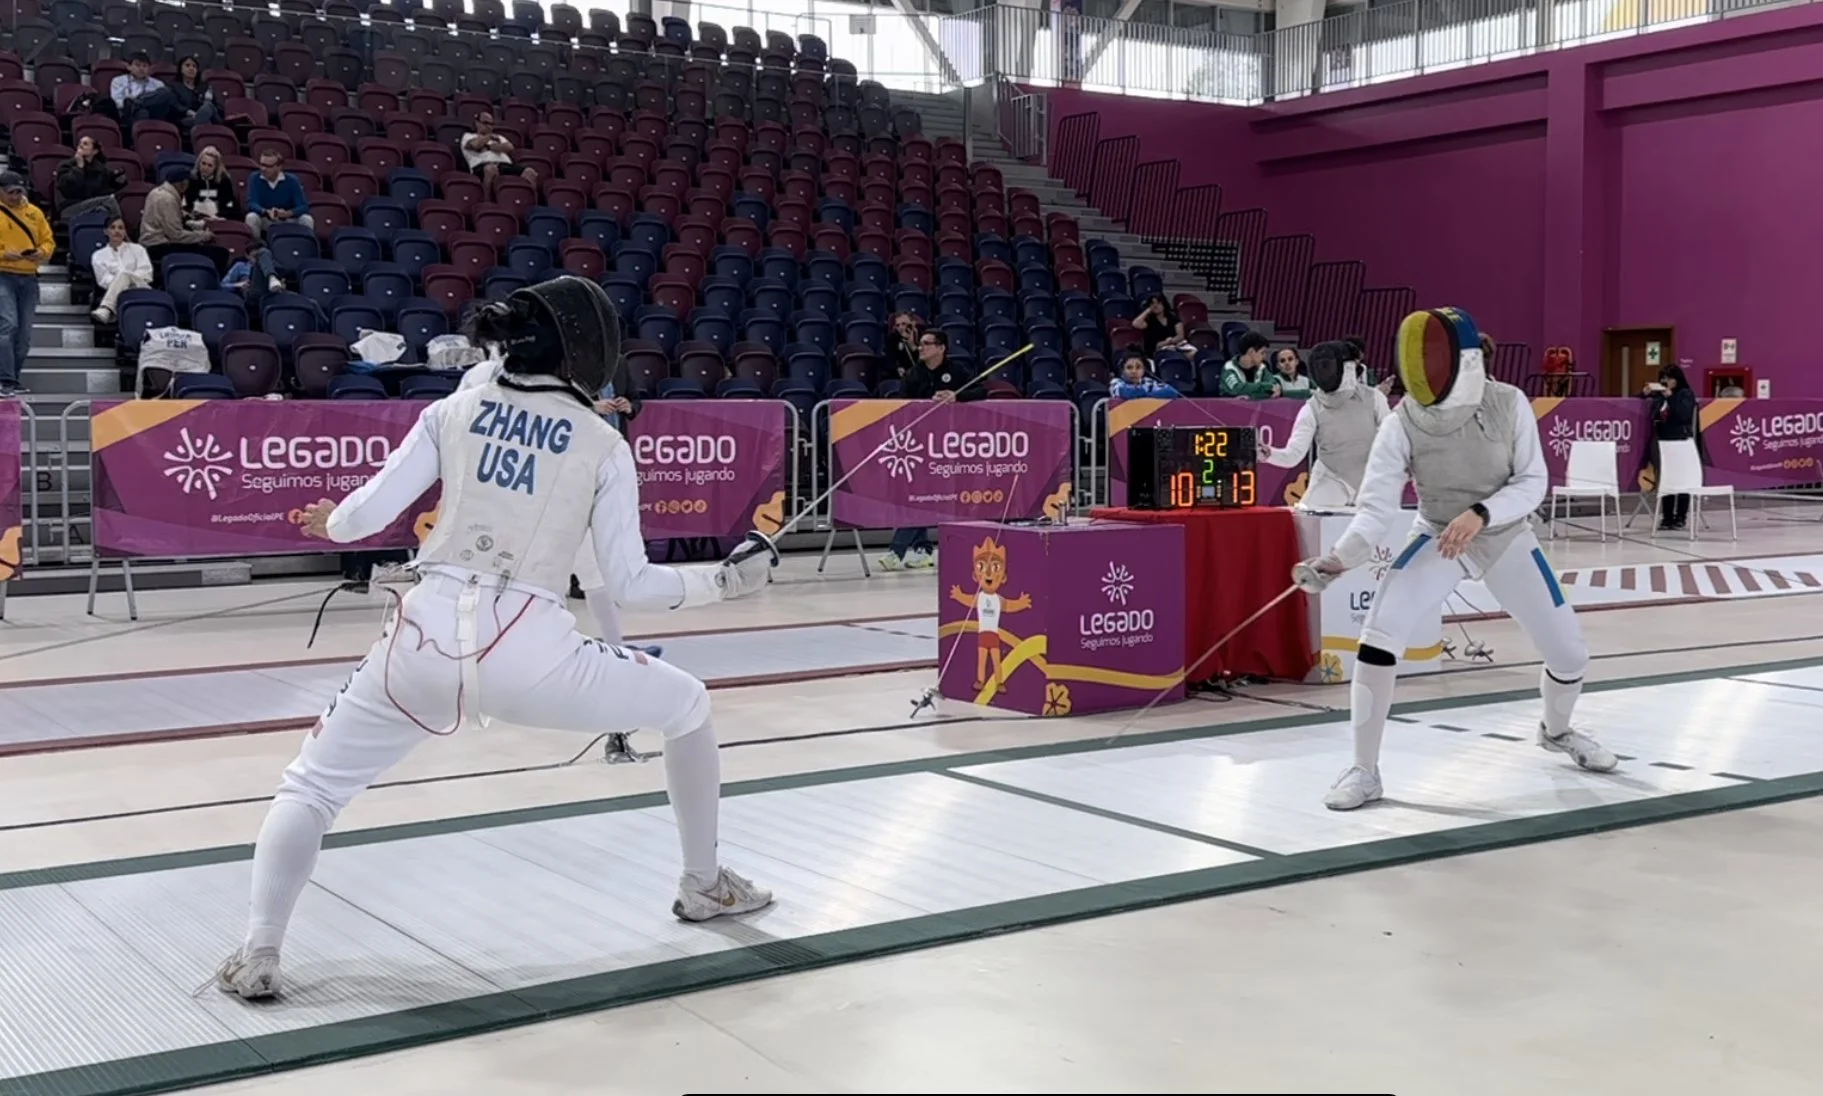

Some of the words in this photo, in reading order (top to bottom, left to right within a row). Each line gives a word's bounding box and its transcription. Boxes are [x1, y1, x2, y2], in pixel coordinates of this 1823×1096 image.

[469, 400, 573, 454] ZHANG
[1195, 432, 1228, 457] 1:22
[477, 442, 536, 495] USA
[637, 468, 683, 486] guimos
[684, 466, 735, 485] jugando
[928, 462, 983, 478] Seguimos
[986, 460, 1028, 477] jugando
[1202, 459, 1214, 484] 2
[241, 473, 323, 494] Seguimos
[326, 473, 376, 491] jugan
[1171, 472, 1194, 507] 10
[1233, 471, 1255, 505] 13
